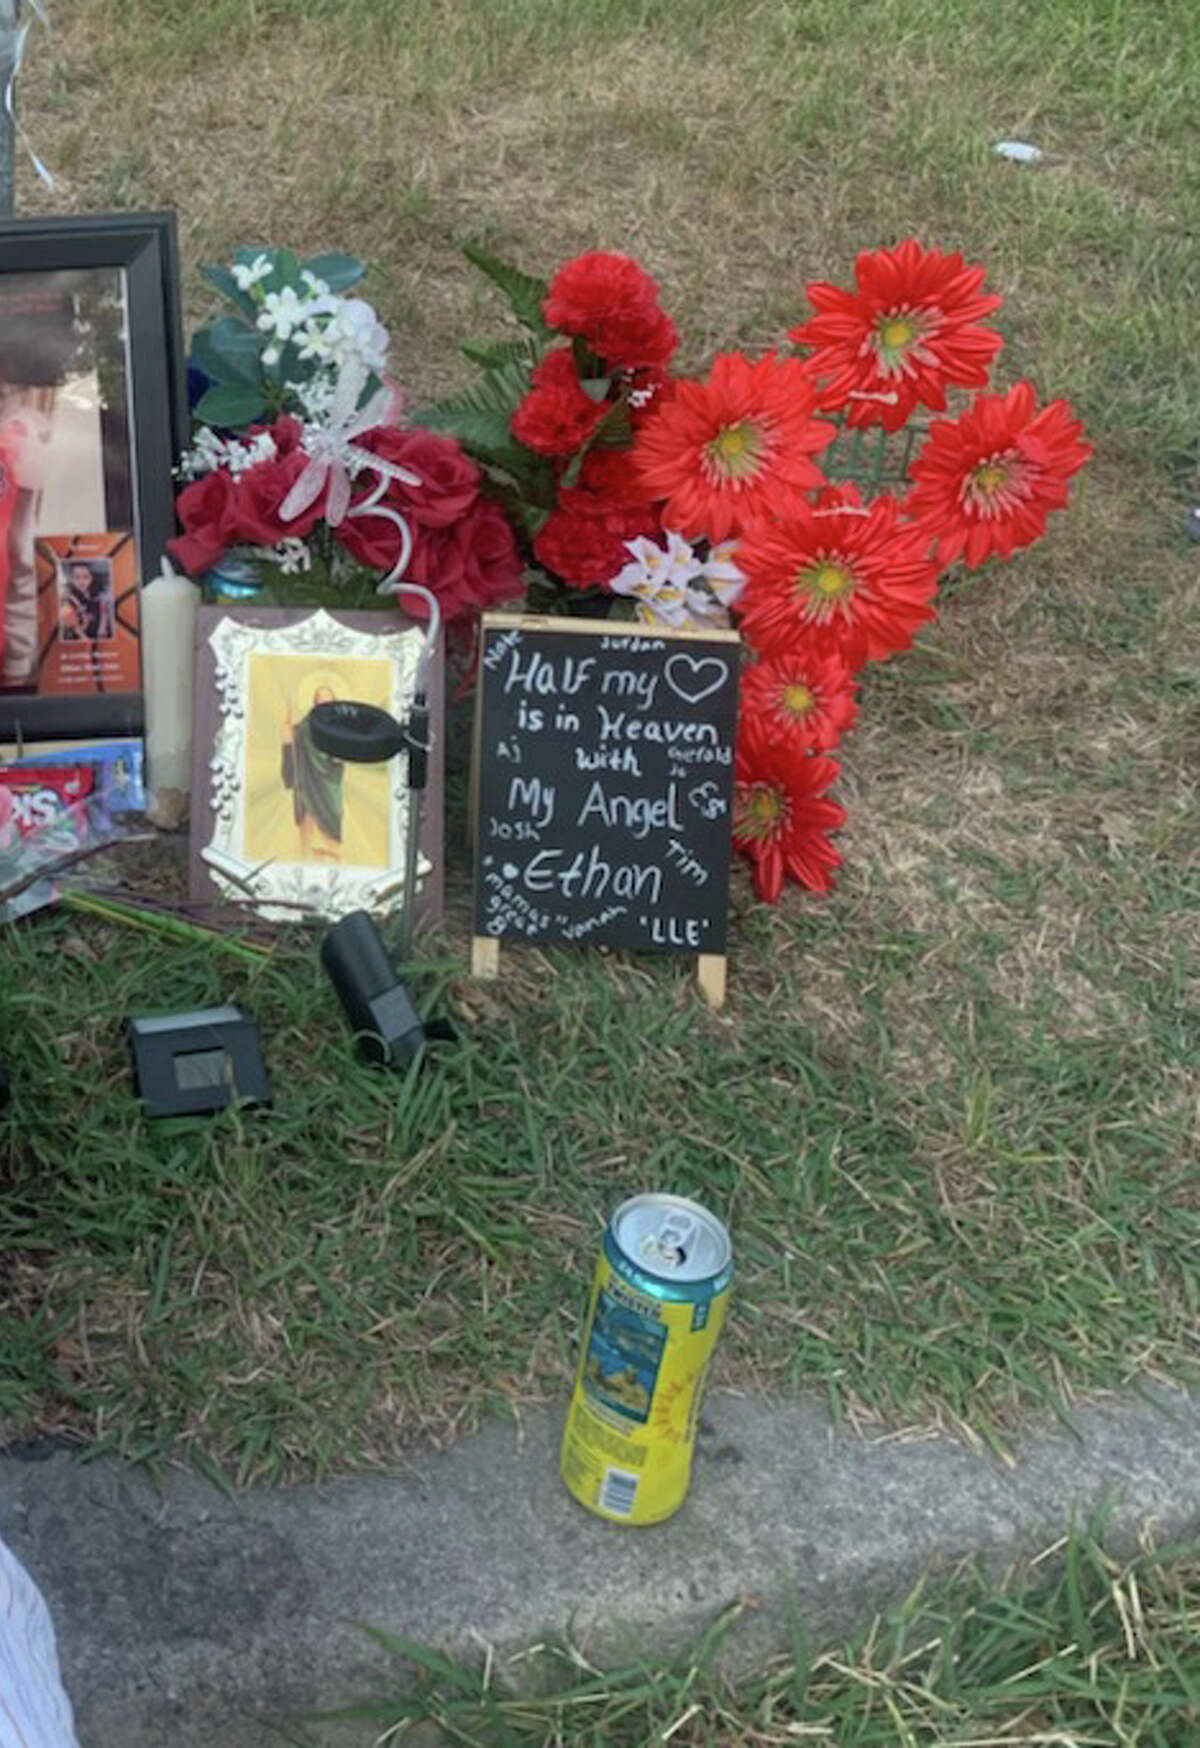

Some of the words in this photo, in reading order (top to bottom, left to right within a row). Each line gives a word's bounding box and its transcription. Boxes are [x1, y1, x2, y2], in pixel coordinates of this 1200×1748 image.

[504, 648, 597, 694] Half
[602, 670, 658, 710] my
[518, 700, 544, 731] is
[555, 703, 580, 732] in
[597, 705, 718, 745] Heaven
[575, 743, 642, 777] with
[490, 816, 541, 841] Josh
[508, 777, 556, 828] My
[577, 781, 684, 840] Angel
[524, 844, 662, 903] Ethan
[665, 838, 709, 887] Tim
